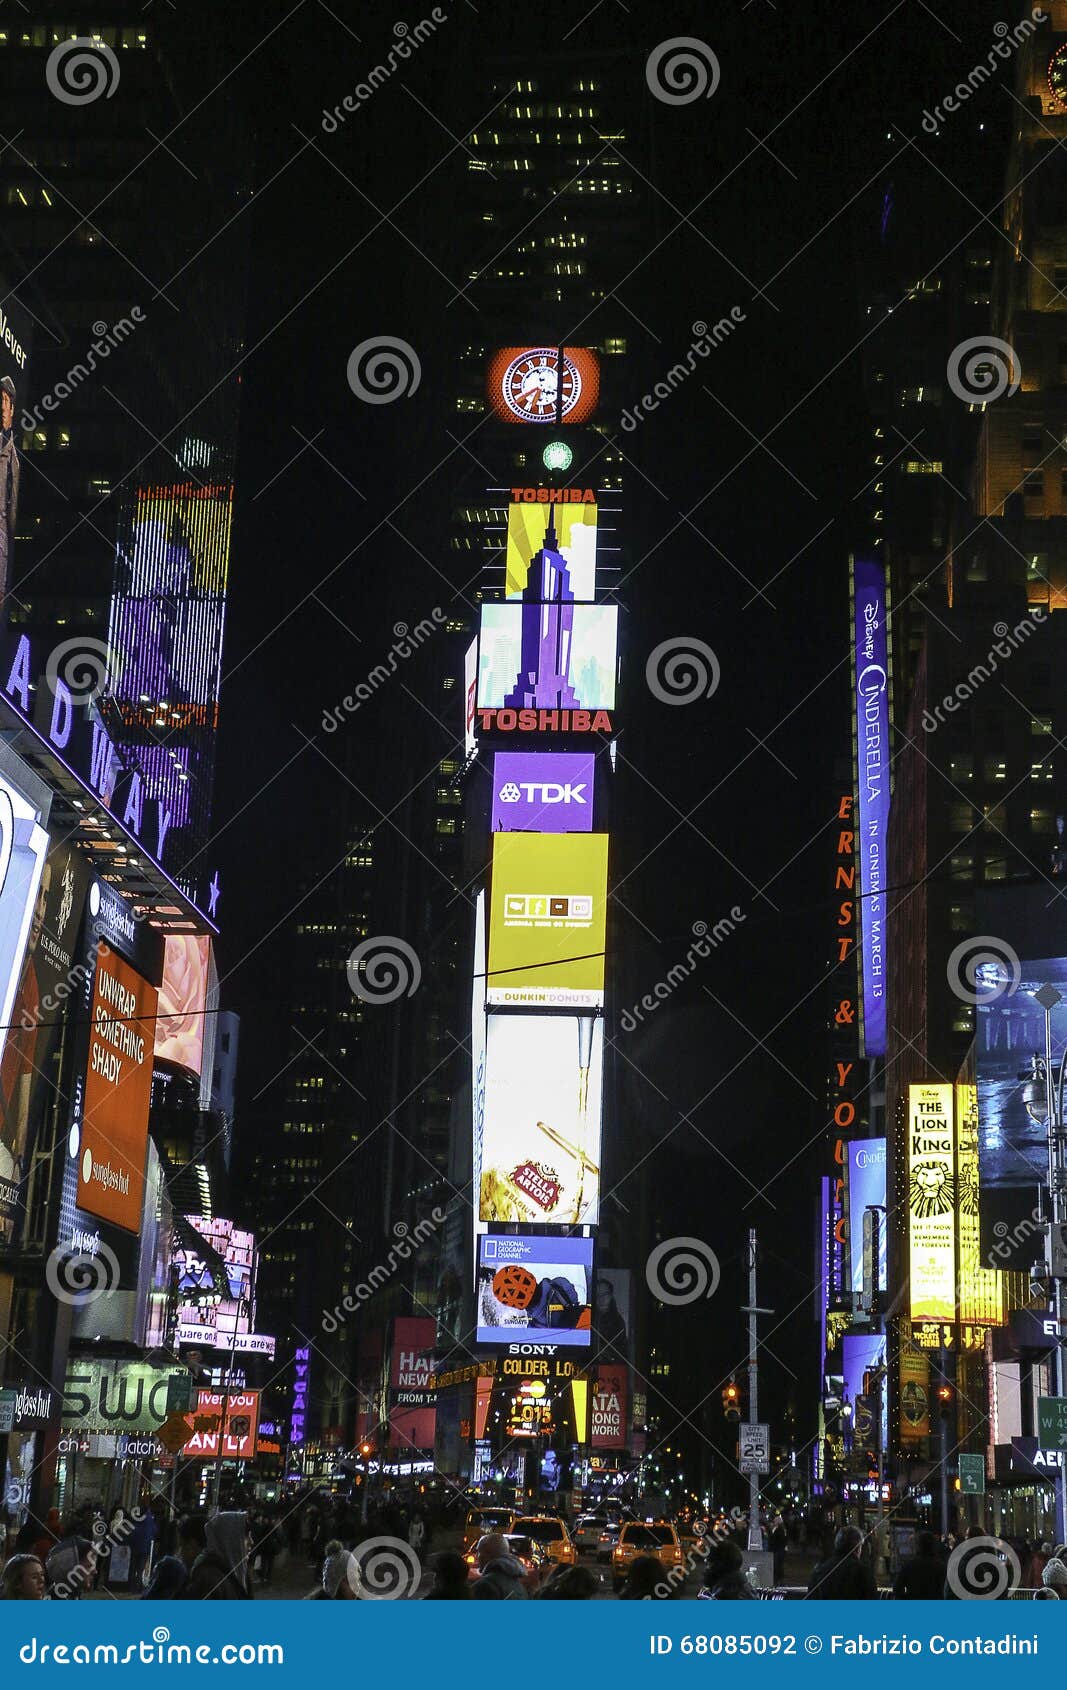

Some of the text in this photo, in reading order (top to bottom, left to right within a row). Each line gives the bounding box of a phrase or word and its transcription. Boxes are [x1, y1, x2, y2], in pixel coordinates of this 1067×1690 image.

[511, 488, 595, 502] TOSHIBA
[477, 708, 612, 733] TOSHIBA
[520, 783, 587, 804] TDK
[868, 820, 878, 836] IN
[835, 796, 855, 961] ERNST
[869, 843, 880, 912] CINEMAS
[871, 920, 882, 976] MARCH
[98, 967, 136, 1018] UNWRAP
[873, 983, 882, 997] 13
[835, 1000, 855, 1024] &
[95, 1005, 145, 1064] SOMETHING
[91, 1042, 122, 1086] SHADY
[918, 1102, 942, 1112] THE
[914, 1116, 947, 1132] LION
[912, 1135, 951, 1155] KING
[516, 1175, 550, 1204] ARTOIS
[522, 1167, 555, 1198] STELLA
[226, 1336, 247, 1348] You
[250, 1340, 265, 1349] are
[509, 1344, 557, 1355] SONY
[399, 1373, 429, 1386] NEW
[229, 1395, 254, 1407] you
[397, 1393, 423, 1403] FROM
[1042, 1418, 1053, 1428] W
[744, 1444, 765, 1457] 25
